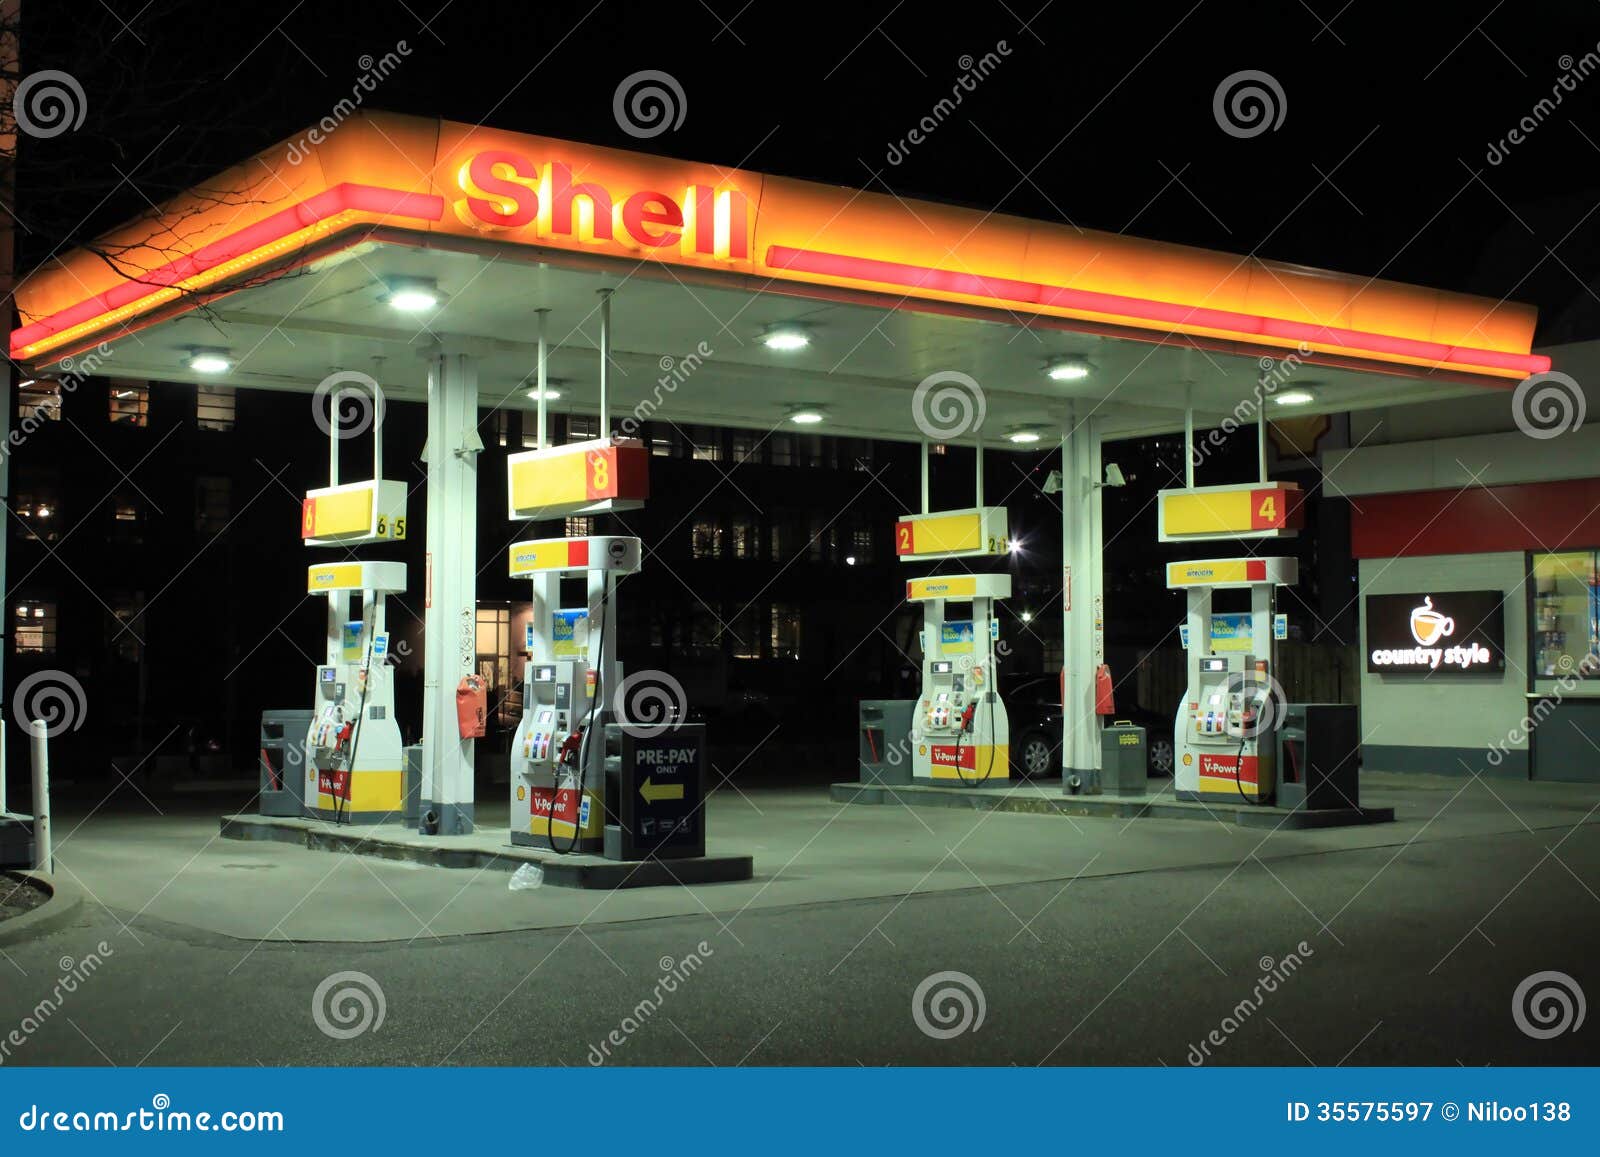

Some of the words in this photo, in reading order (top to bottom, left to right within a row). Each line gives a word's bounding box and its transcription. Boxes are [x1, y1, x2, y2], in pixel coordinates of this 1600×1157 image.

[462, 149, 749, 260] Shell
[593, 456, 609, 491] 8
[305, 505, 313, 532] 6
[1258, 496, 1277, 522] 4
[377, 517, 386, 534] 6
[395, 519, 404, 536] 5
[899, 527, 910, 550] 2
[988, 538, 995, 552] 2
[1371, 646, 1442, 669] country
[1444, 642, 1491, 669] style
[636, 748, 697, 766] PRE-PAY
[656, 765, 678, 774] ONLY
